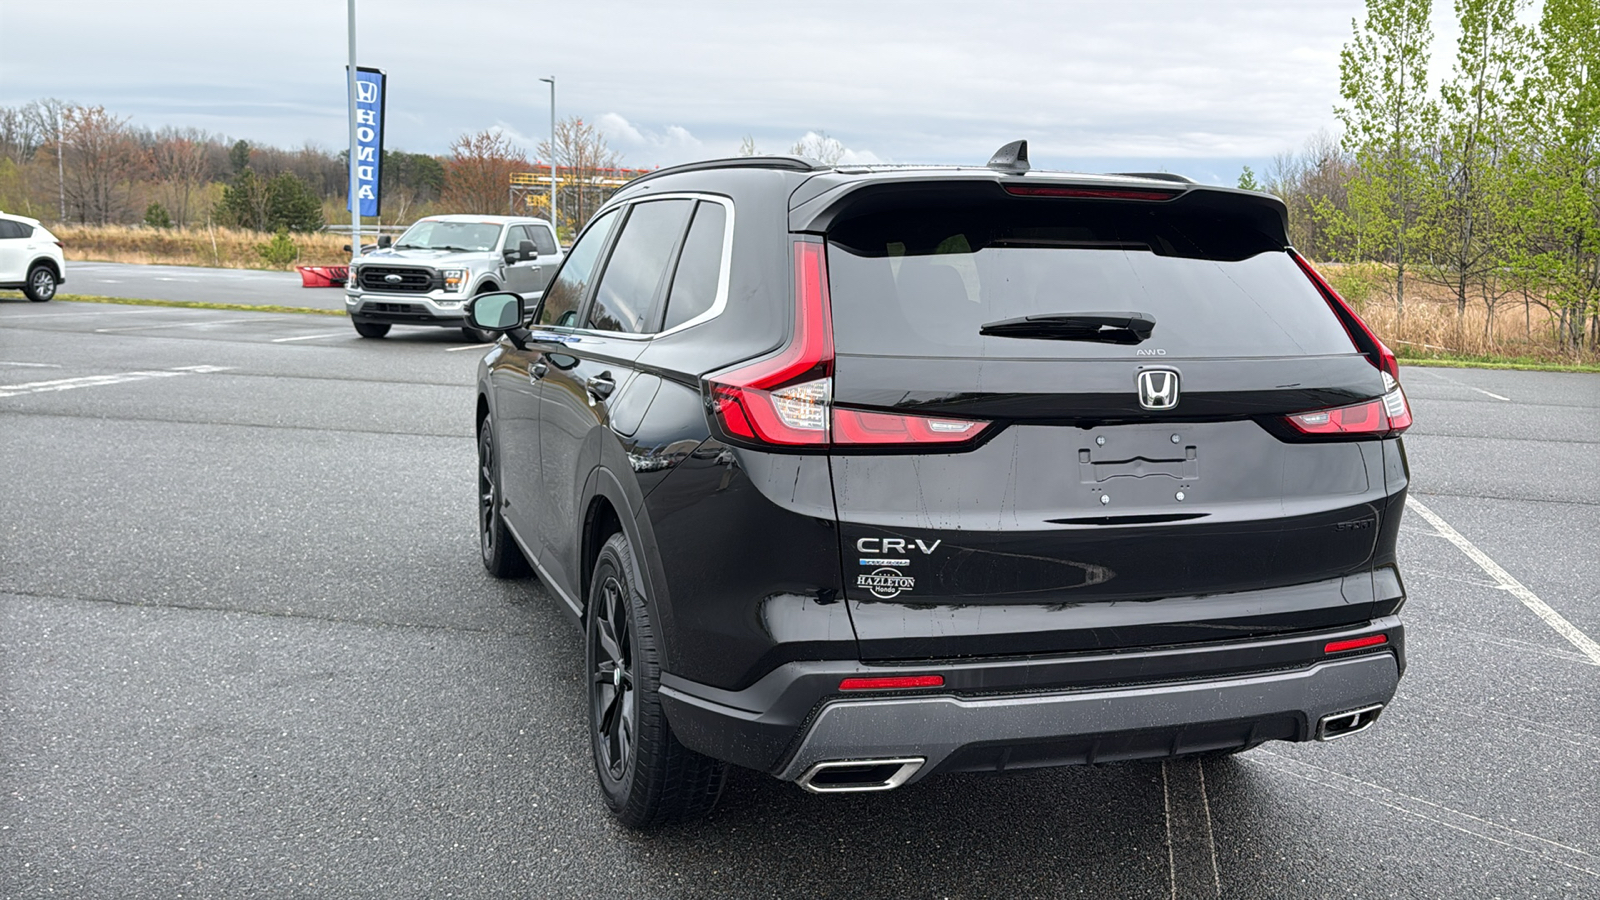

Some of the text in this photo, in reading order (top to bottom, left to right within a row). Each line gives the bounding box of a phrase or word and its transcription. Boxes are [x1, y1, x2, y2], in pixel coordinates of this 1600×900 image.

[1136, 348, 1167, 356] AWD
[856, 537, 942, 555] CR-V
[856, 576, 915, 588] HAZLETON
